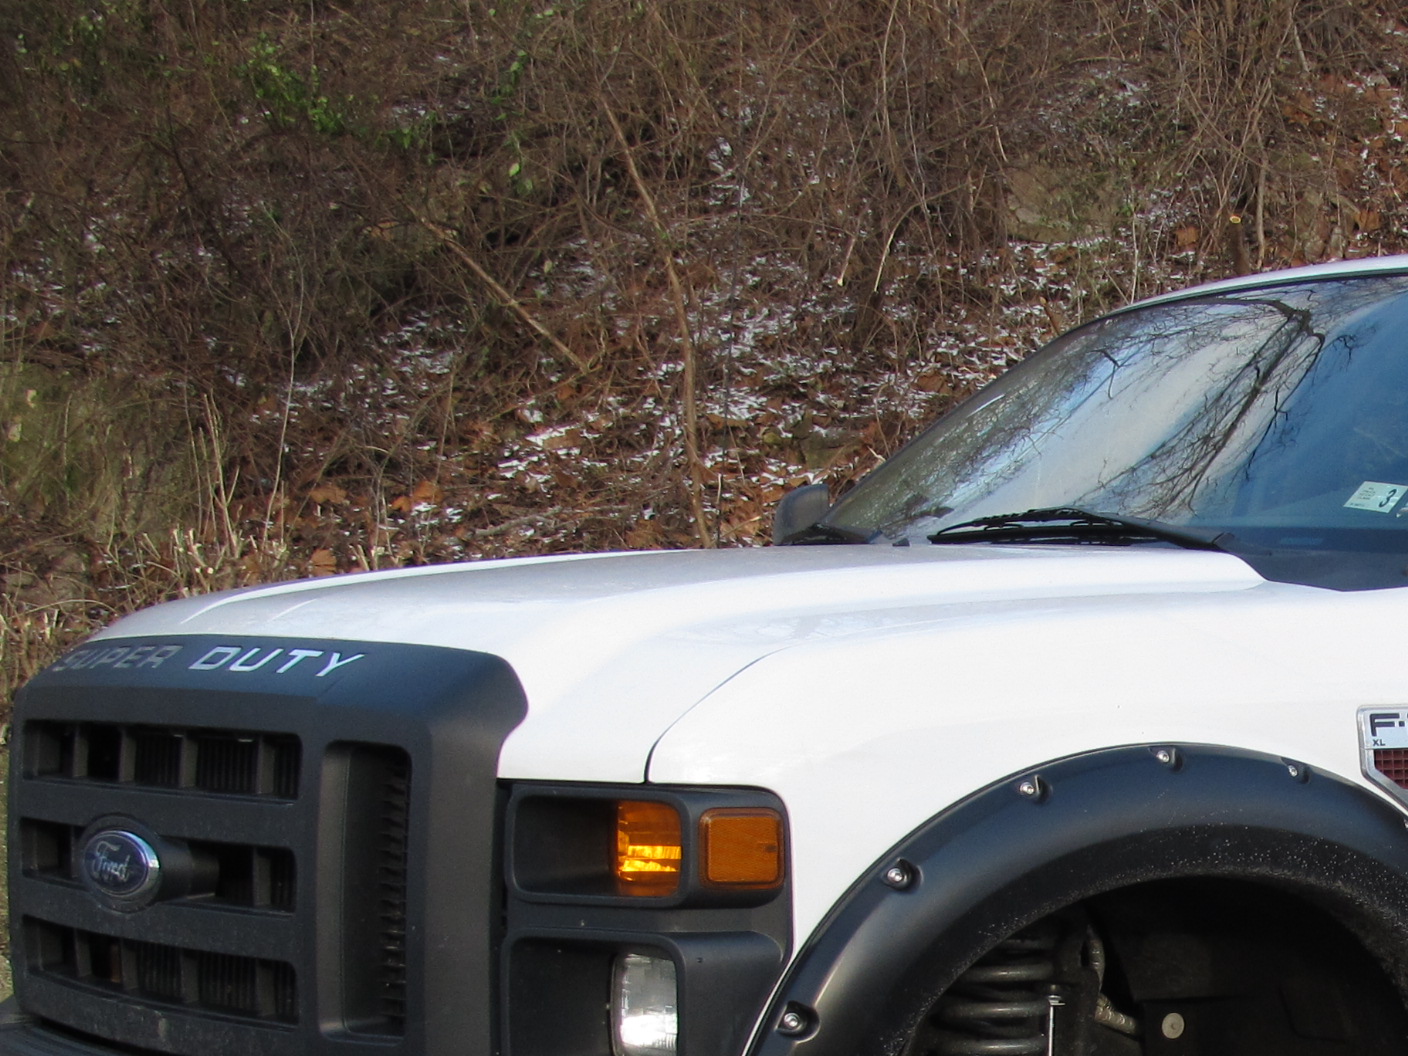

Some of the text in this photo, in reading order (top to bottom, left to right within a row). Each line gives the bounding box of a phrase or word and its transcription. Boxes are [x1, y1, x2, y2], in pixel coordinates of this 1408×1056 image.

[1378, 488, 1397, 508] 3
[52, 645, 367, 678] SUPER DUTY
[1372, 739, 1386, 747] XL
[91, 840, 132, 883] Ford
